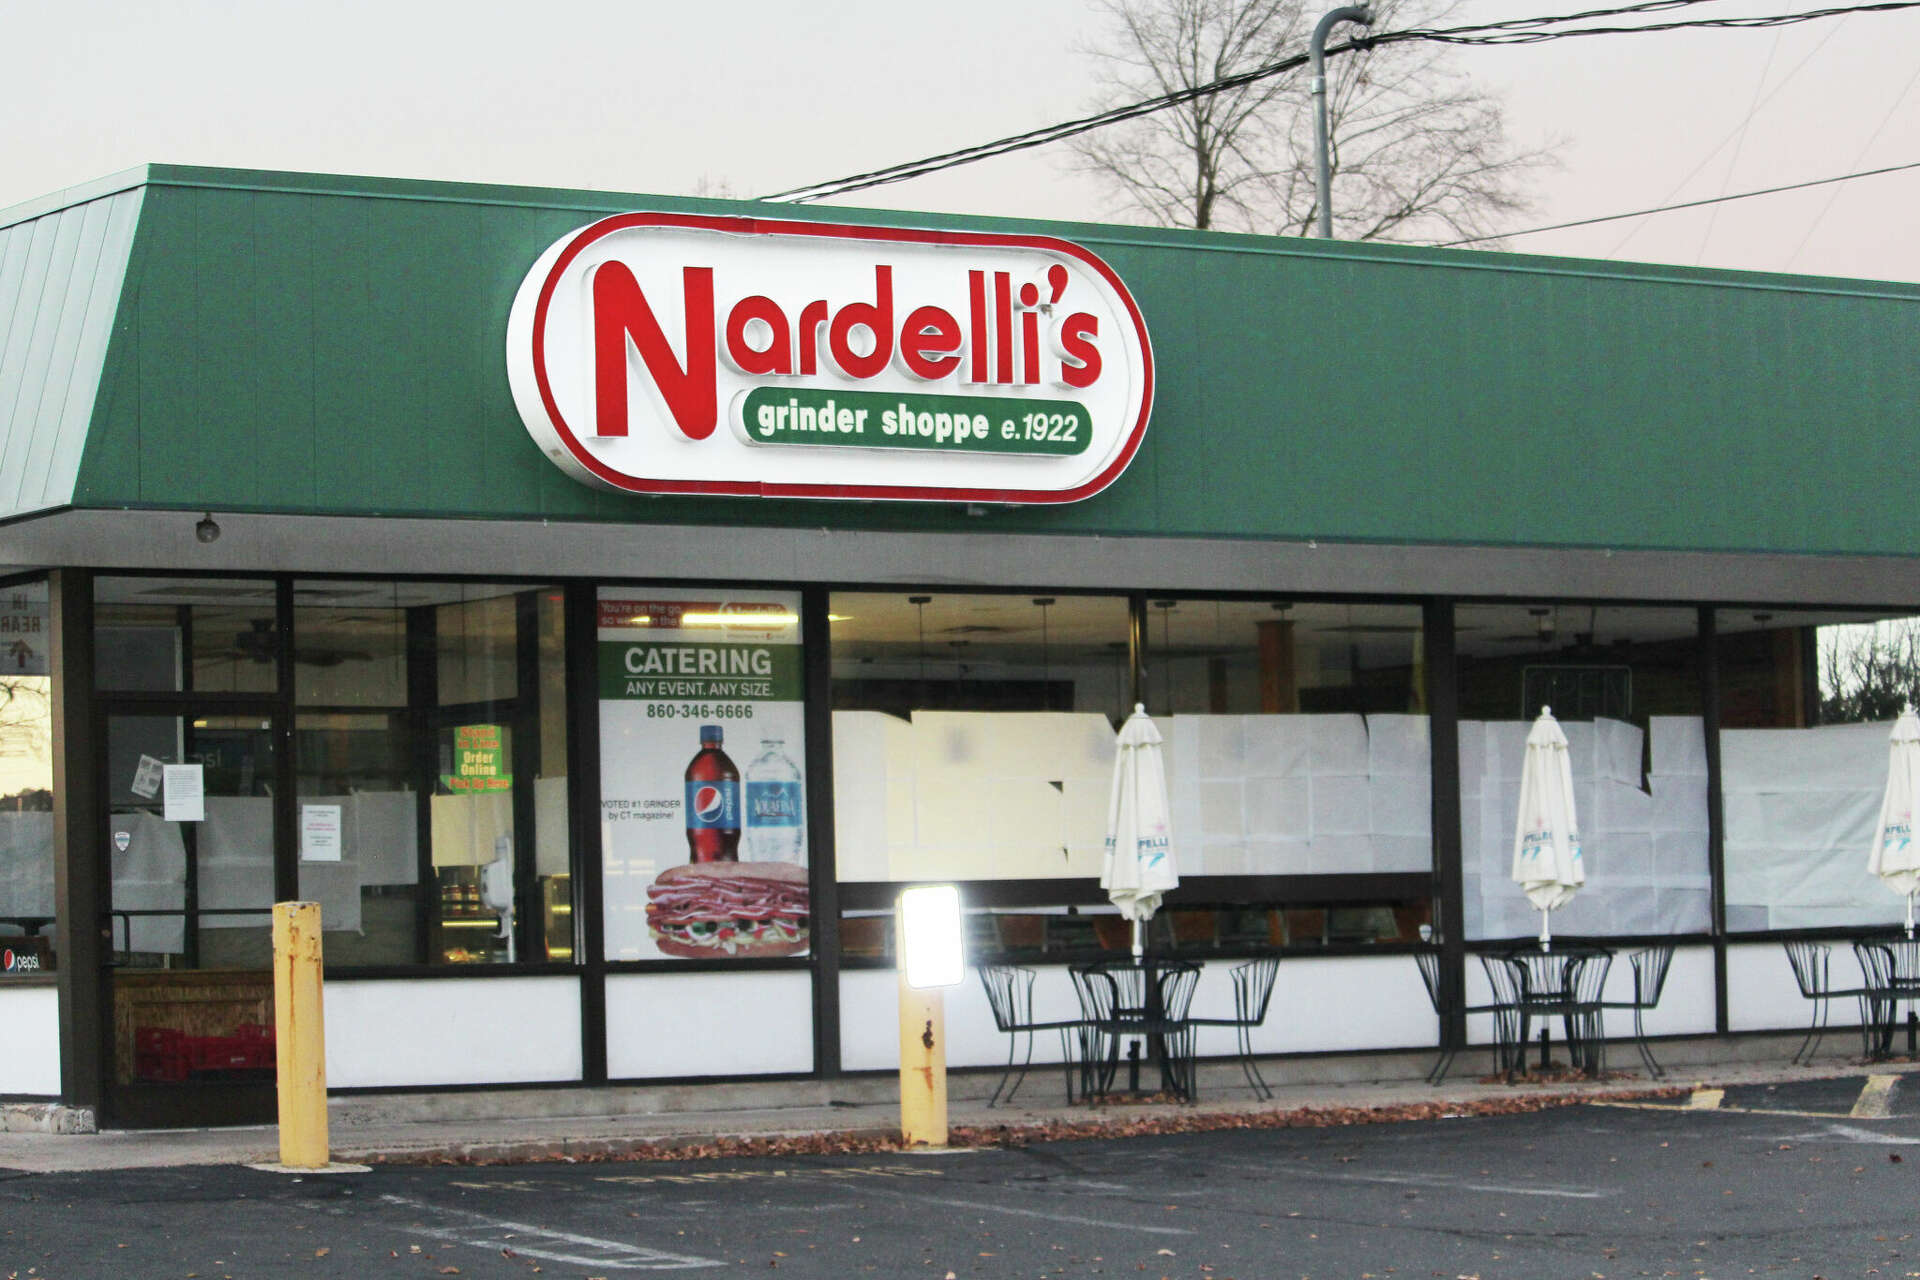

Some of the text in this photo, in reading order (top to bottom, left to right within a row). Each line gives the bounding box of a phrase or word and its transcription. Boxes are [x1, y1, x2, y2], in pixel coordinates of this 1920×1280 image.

[593, 260, 1102, 440] Nardelli's
[758, 398, 1078, 443] grinder shoppe e.1922
[624, 647, 772, 675] CATERING
[626, 681, 656, 696] ANY
[658, 682, 707, 696] EVENT.
[709, 682, 738, 697] ANY
[647, 703, 753, 719] 860-346-6666
[463, 751, 494, 764] Order
[460, 763, 497, 776] Online
[600, 800, 630, 809] VOTED
[643, 800, 681, 809] GRINDER
[608, 811, 618, 821] by
[620, 810, 630, 820] CT
[16, 953, 40, 973] pepsi
